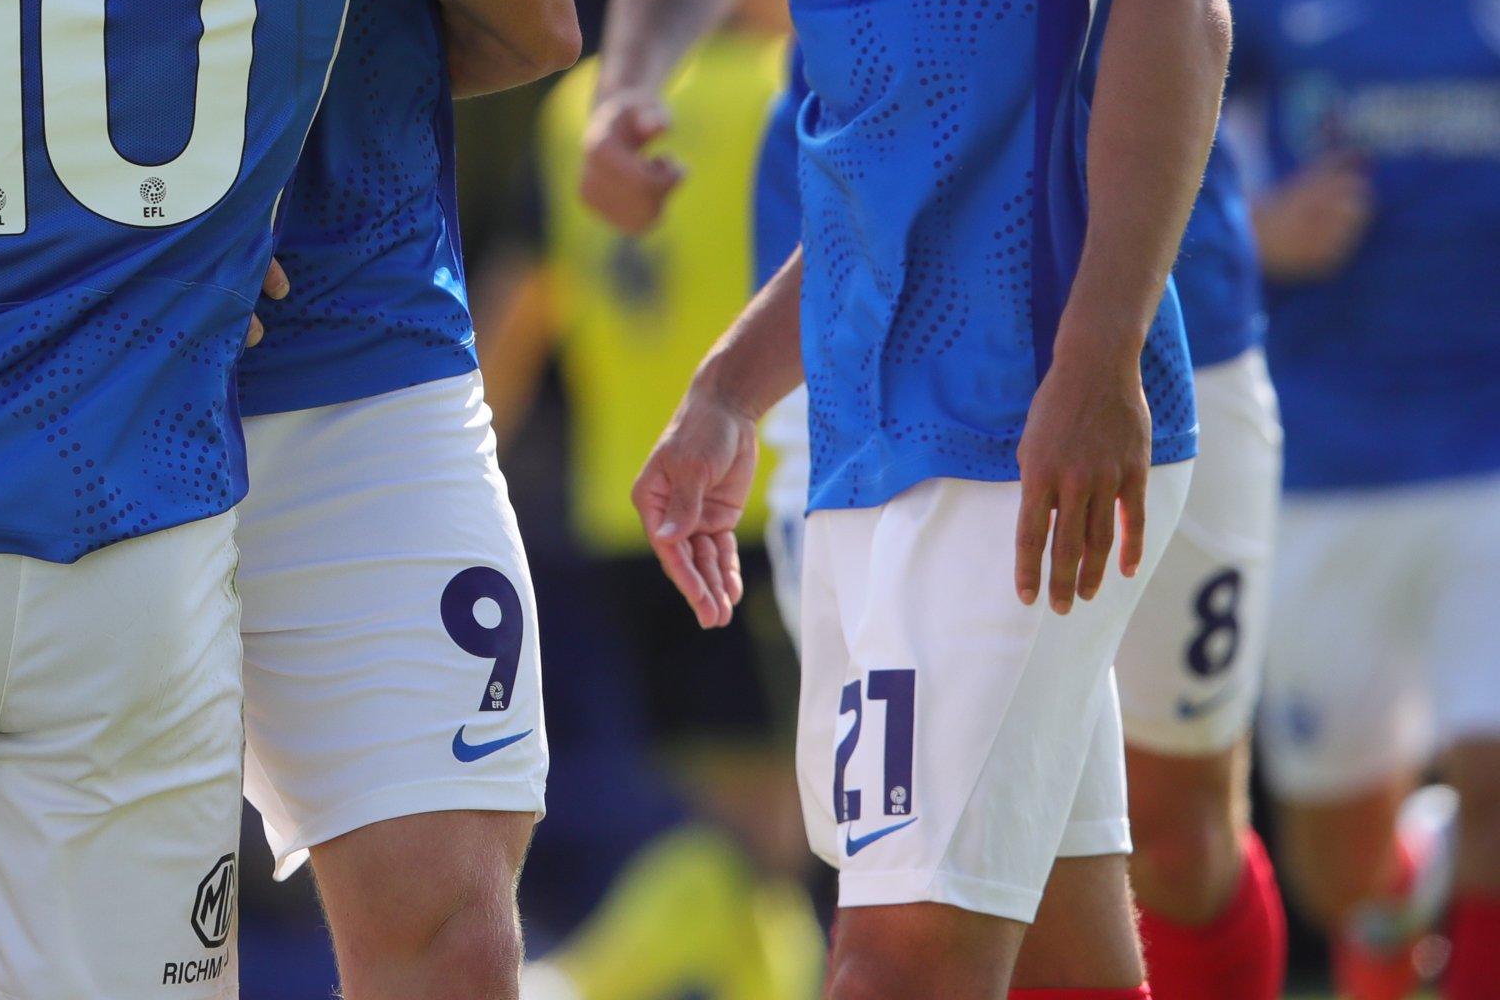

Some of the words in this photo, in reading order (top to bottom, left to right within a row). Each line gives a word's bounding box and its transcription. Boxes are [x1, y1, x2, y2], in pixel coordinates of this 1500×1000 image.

[143, 206, 165, 218] EFL
[440, 565, 524, 712] 9
[1184, 567, 1242, 679] 8
[491, 700, 505, 709] EFL
[833, 668, 916, 825] 21
[891, 804, 905, 814] EFL
